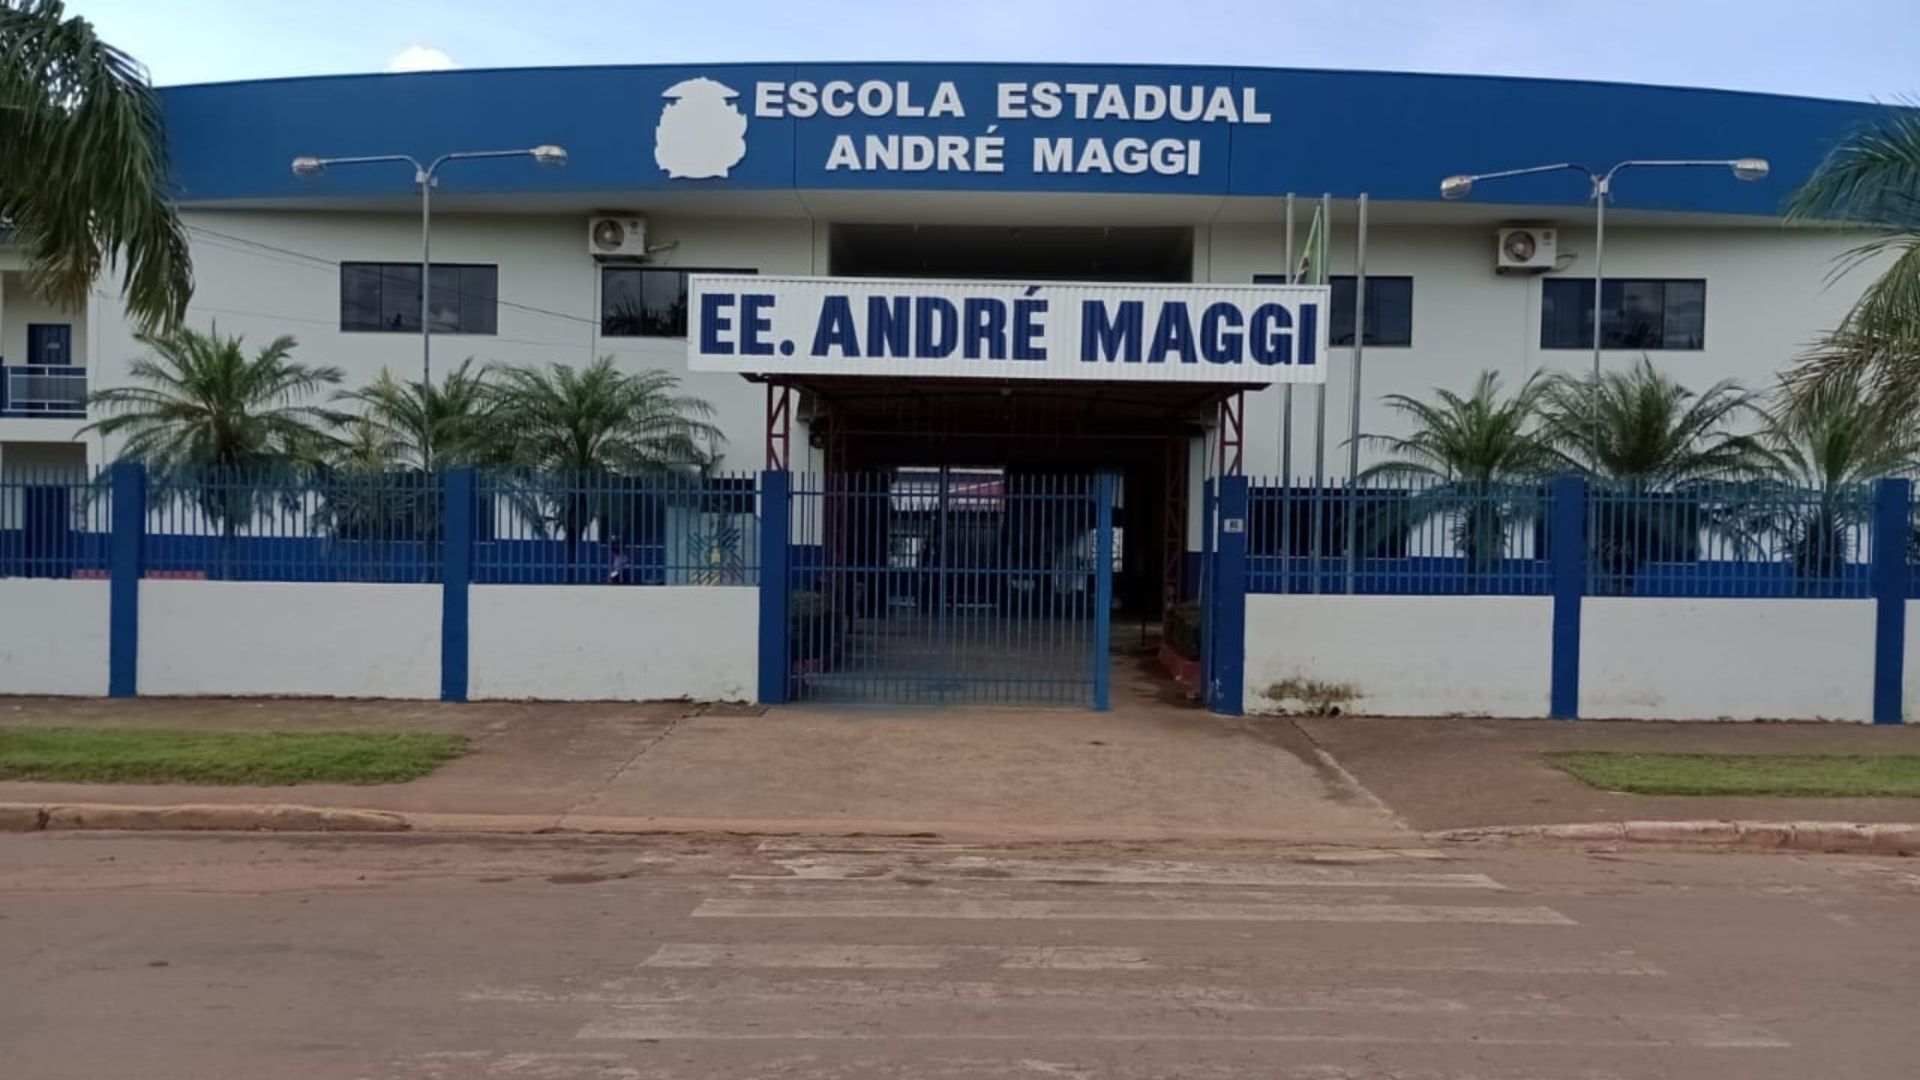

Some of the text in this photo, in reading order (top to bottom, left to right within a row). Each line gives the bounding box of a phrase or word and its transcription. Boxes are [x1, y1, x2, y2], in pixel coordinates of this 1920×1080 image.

[755, 80, 1272, 124] ESCOLA ESTADUAL
[825, 126, 1202, 175] ANDRÉ MAGGI
[699, 285, 1319, 366] EE. ANDRÉ MAGGI
